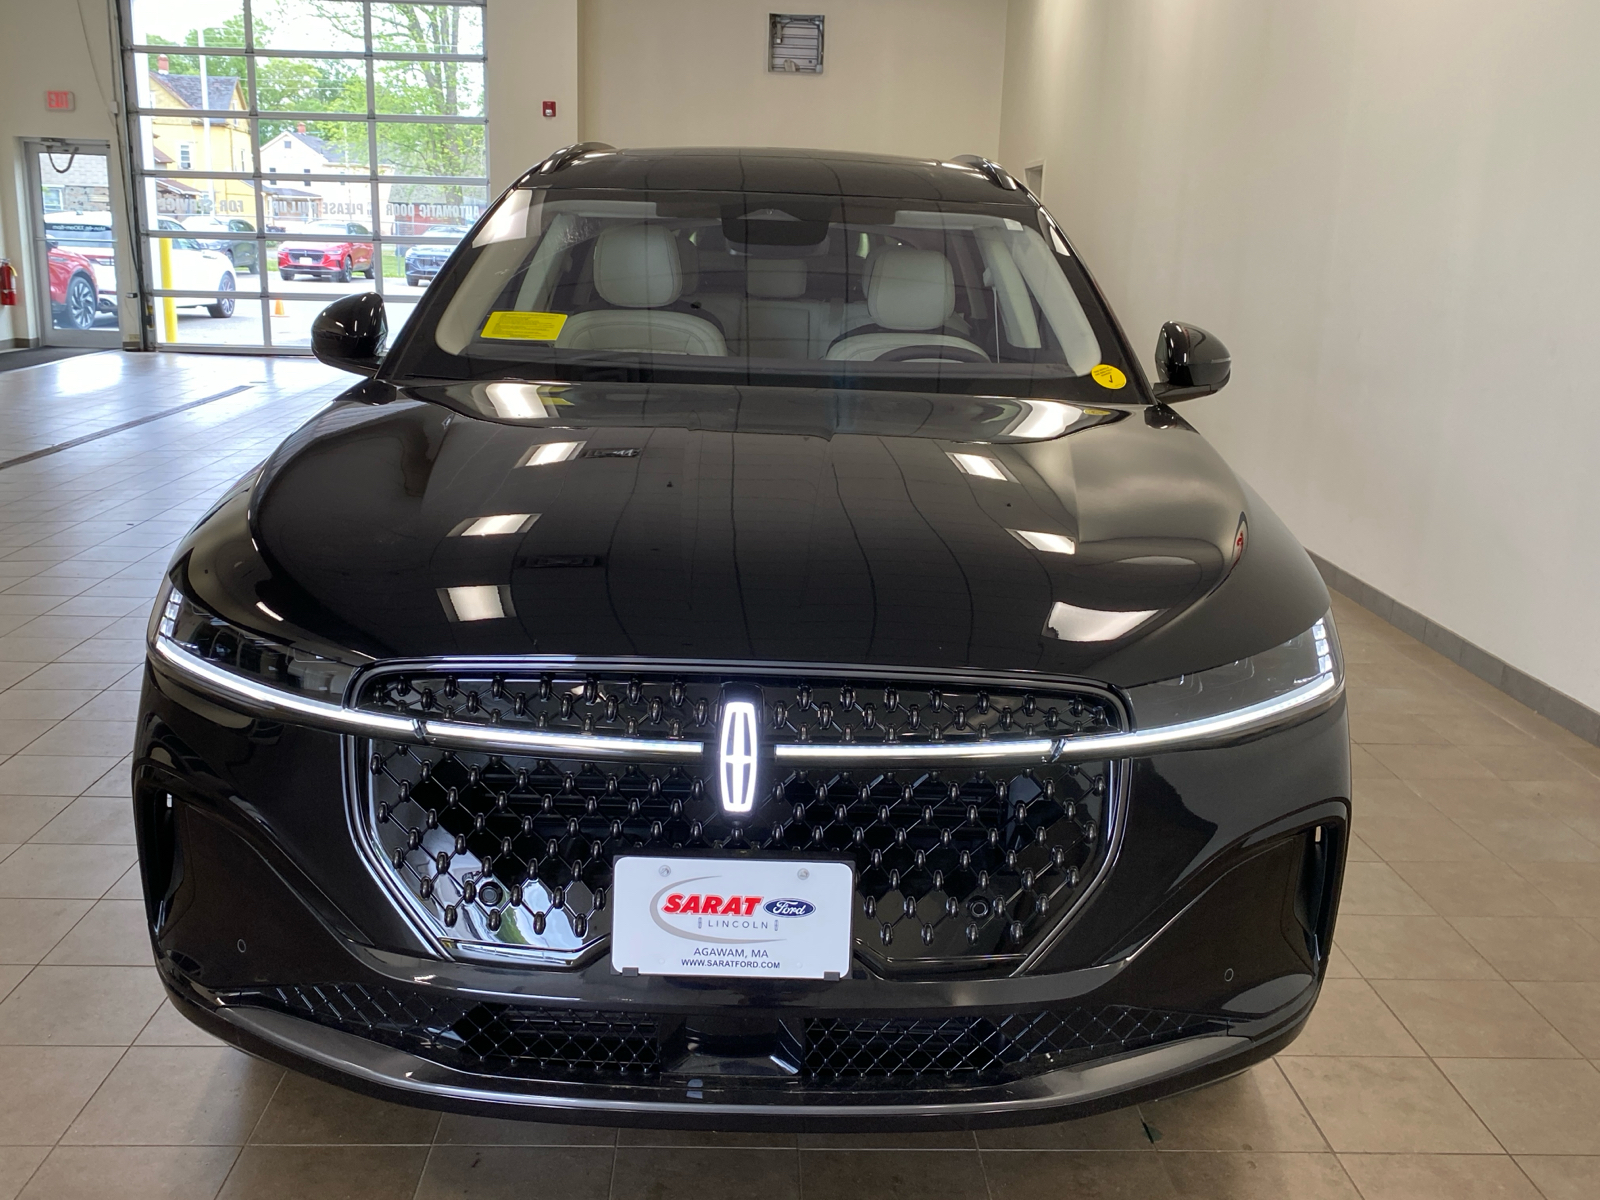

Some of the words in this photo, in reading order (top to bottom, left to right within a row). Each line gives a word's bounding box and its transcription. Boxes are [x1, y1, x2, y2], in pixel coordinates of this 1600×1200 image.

[661, 892, 763, 916] SARAT
[773, 901, 806, 915] Ford
[708, 919, 768, 929] LINCOLN
[693, 947, 748, 959] AGAWAM,
[751, 949, 769, 958] MA
[681, 959, 781, 969] WWW.SARATFORD.COM
